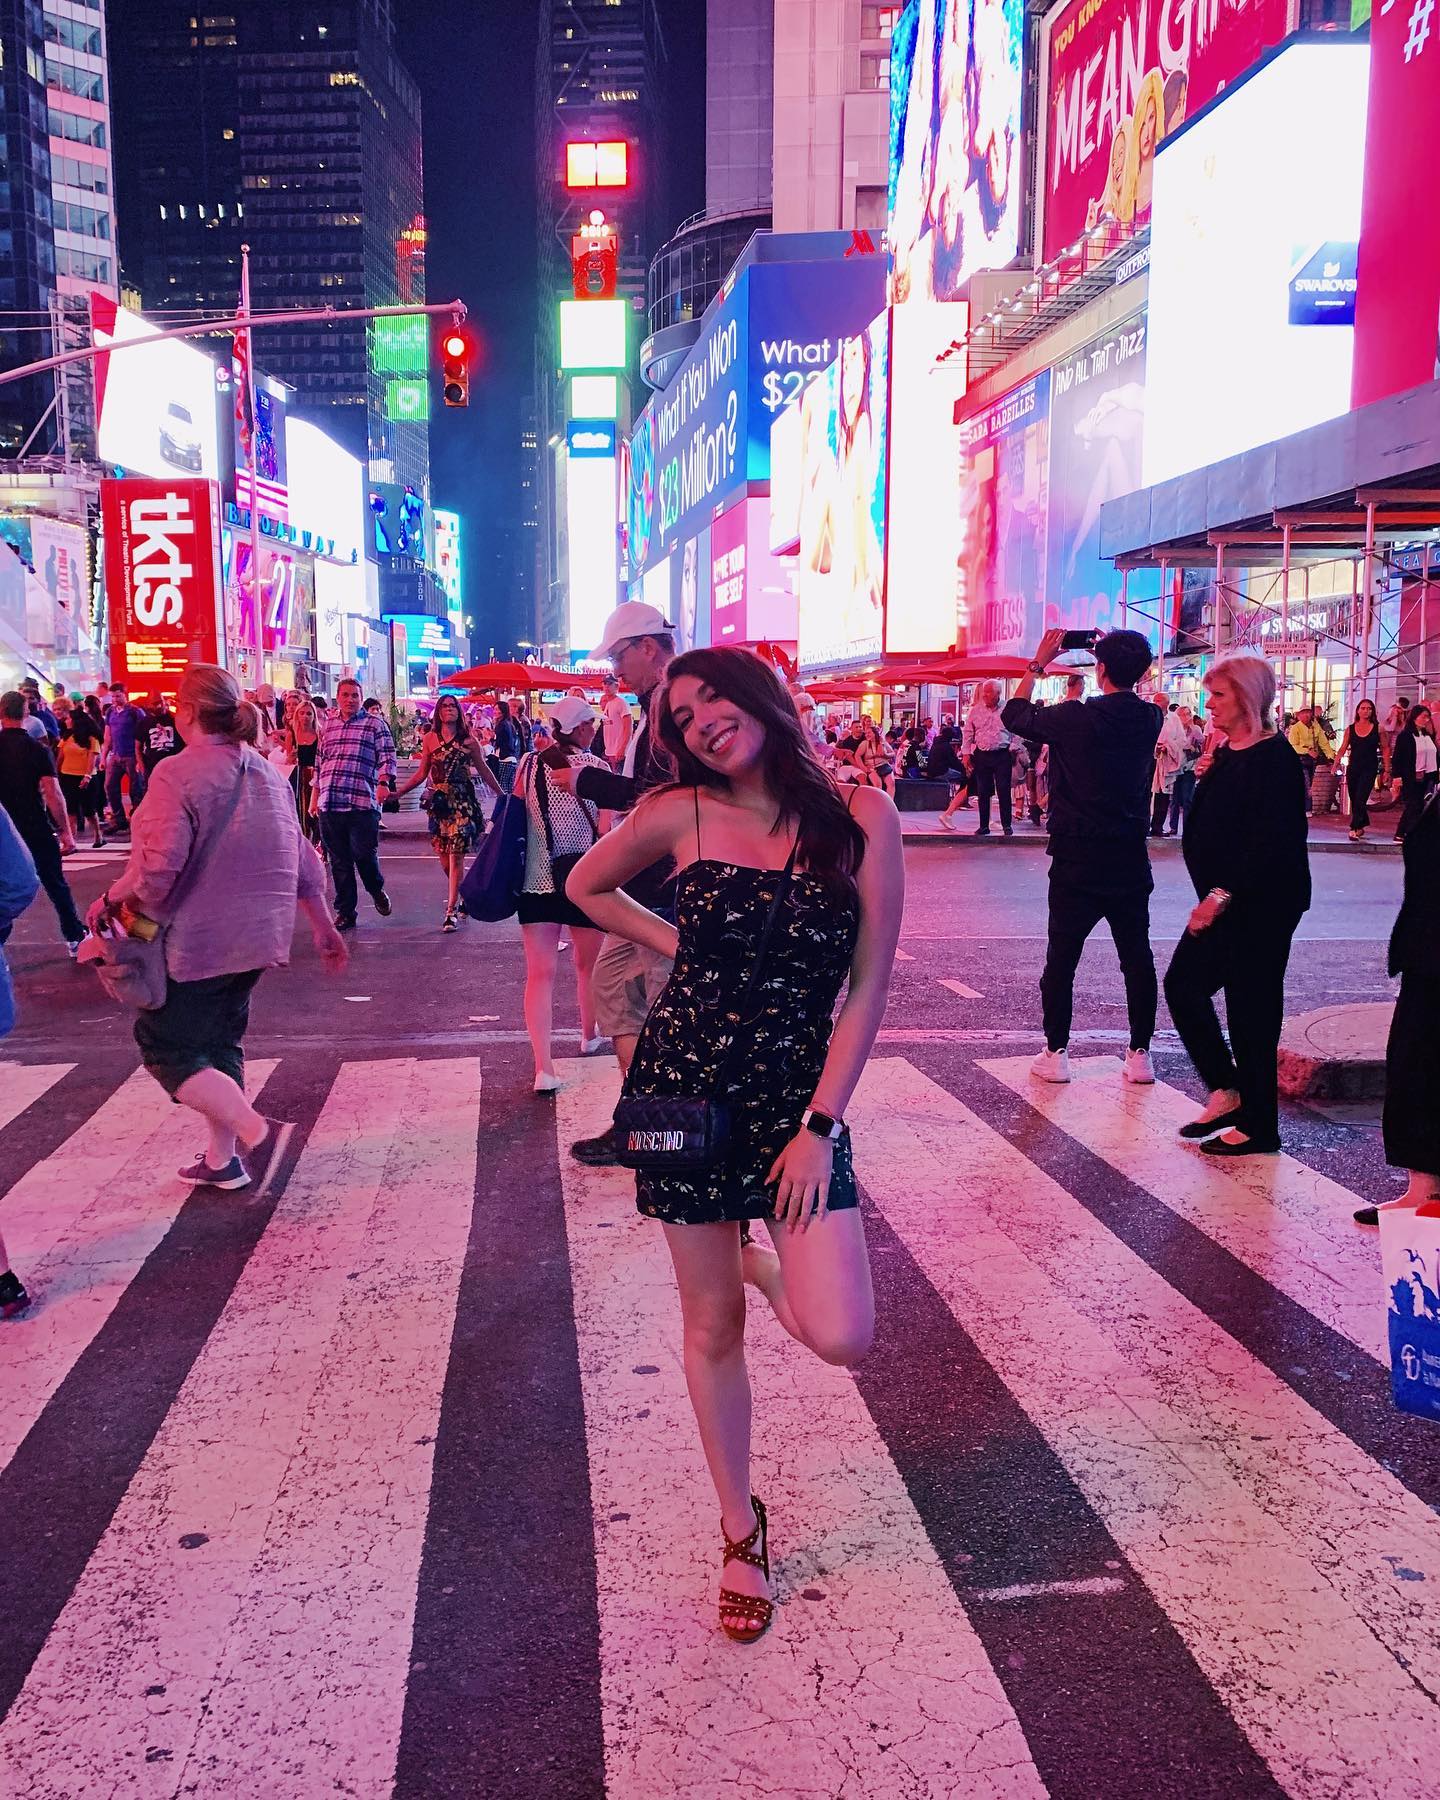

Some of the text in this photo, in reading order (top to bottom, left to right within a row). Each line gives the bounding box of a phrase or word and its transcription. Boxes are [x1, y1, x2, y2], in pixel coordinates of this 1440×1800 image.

[1055, 18, 1075, 58] YOU
[1053, 0, 1147, 195] MEAN
[761, 338, 830, 364] What
[1056, 326, 1145, 396] AND ALL THAT JAZZ
[217, 382, 230, 392] LG
[658, 385, 679, 453] What
[681, 373, 687, 426] If
[688, 358, 707, 414] You
[709, 319, 737, 389] Won
[968, 421, 988, 445] SARA
[991, 392, 1035, 433] BAREILLES
[659, 390, 737, 547] $23 Million?
[225, 502, 335, 557] BROADWAY
[124, 566, 132, 608] Development
[269, 560, 296, 629] 21
[541, 661, 584, 675] Cousins
[627, 1130, 684, 1151] MOSCHINO
